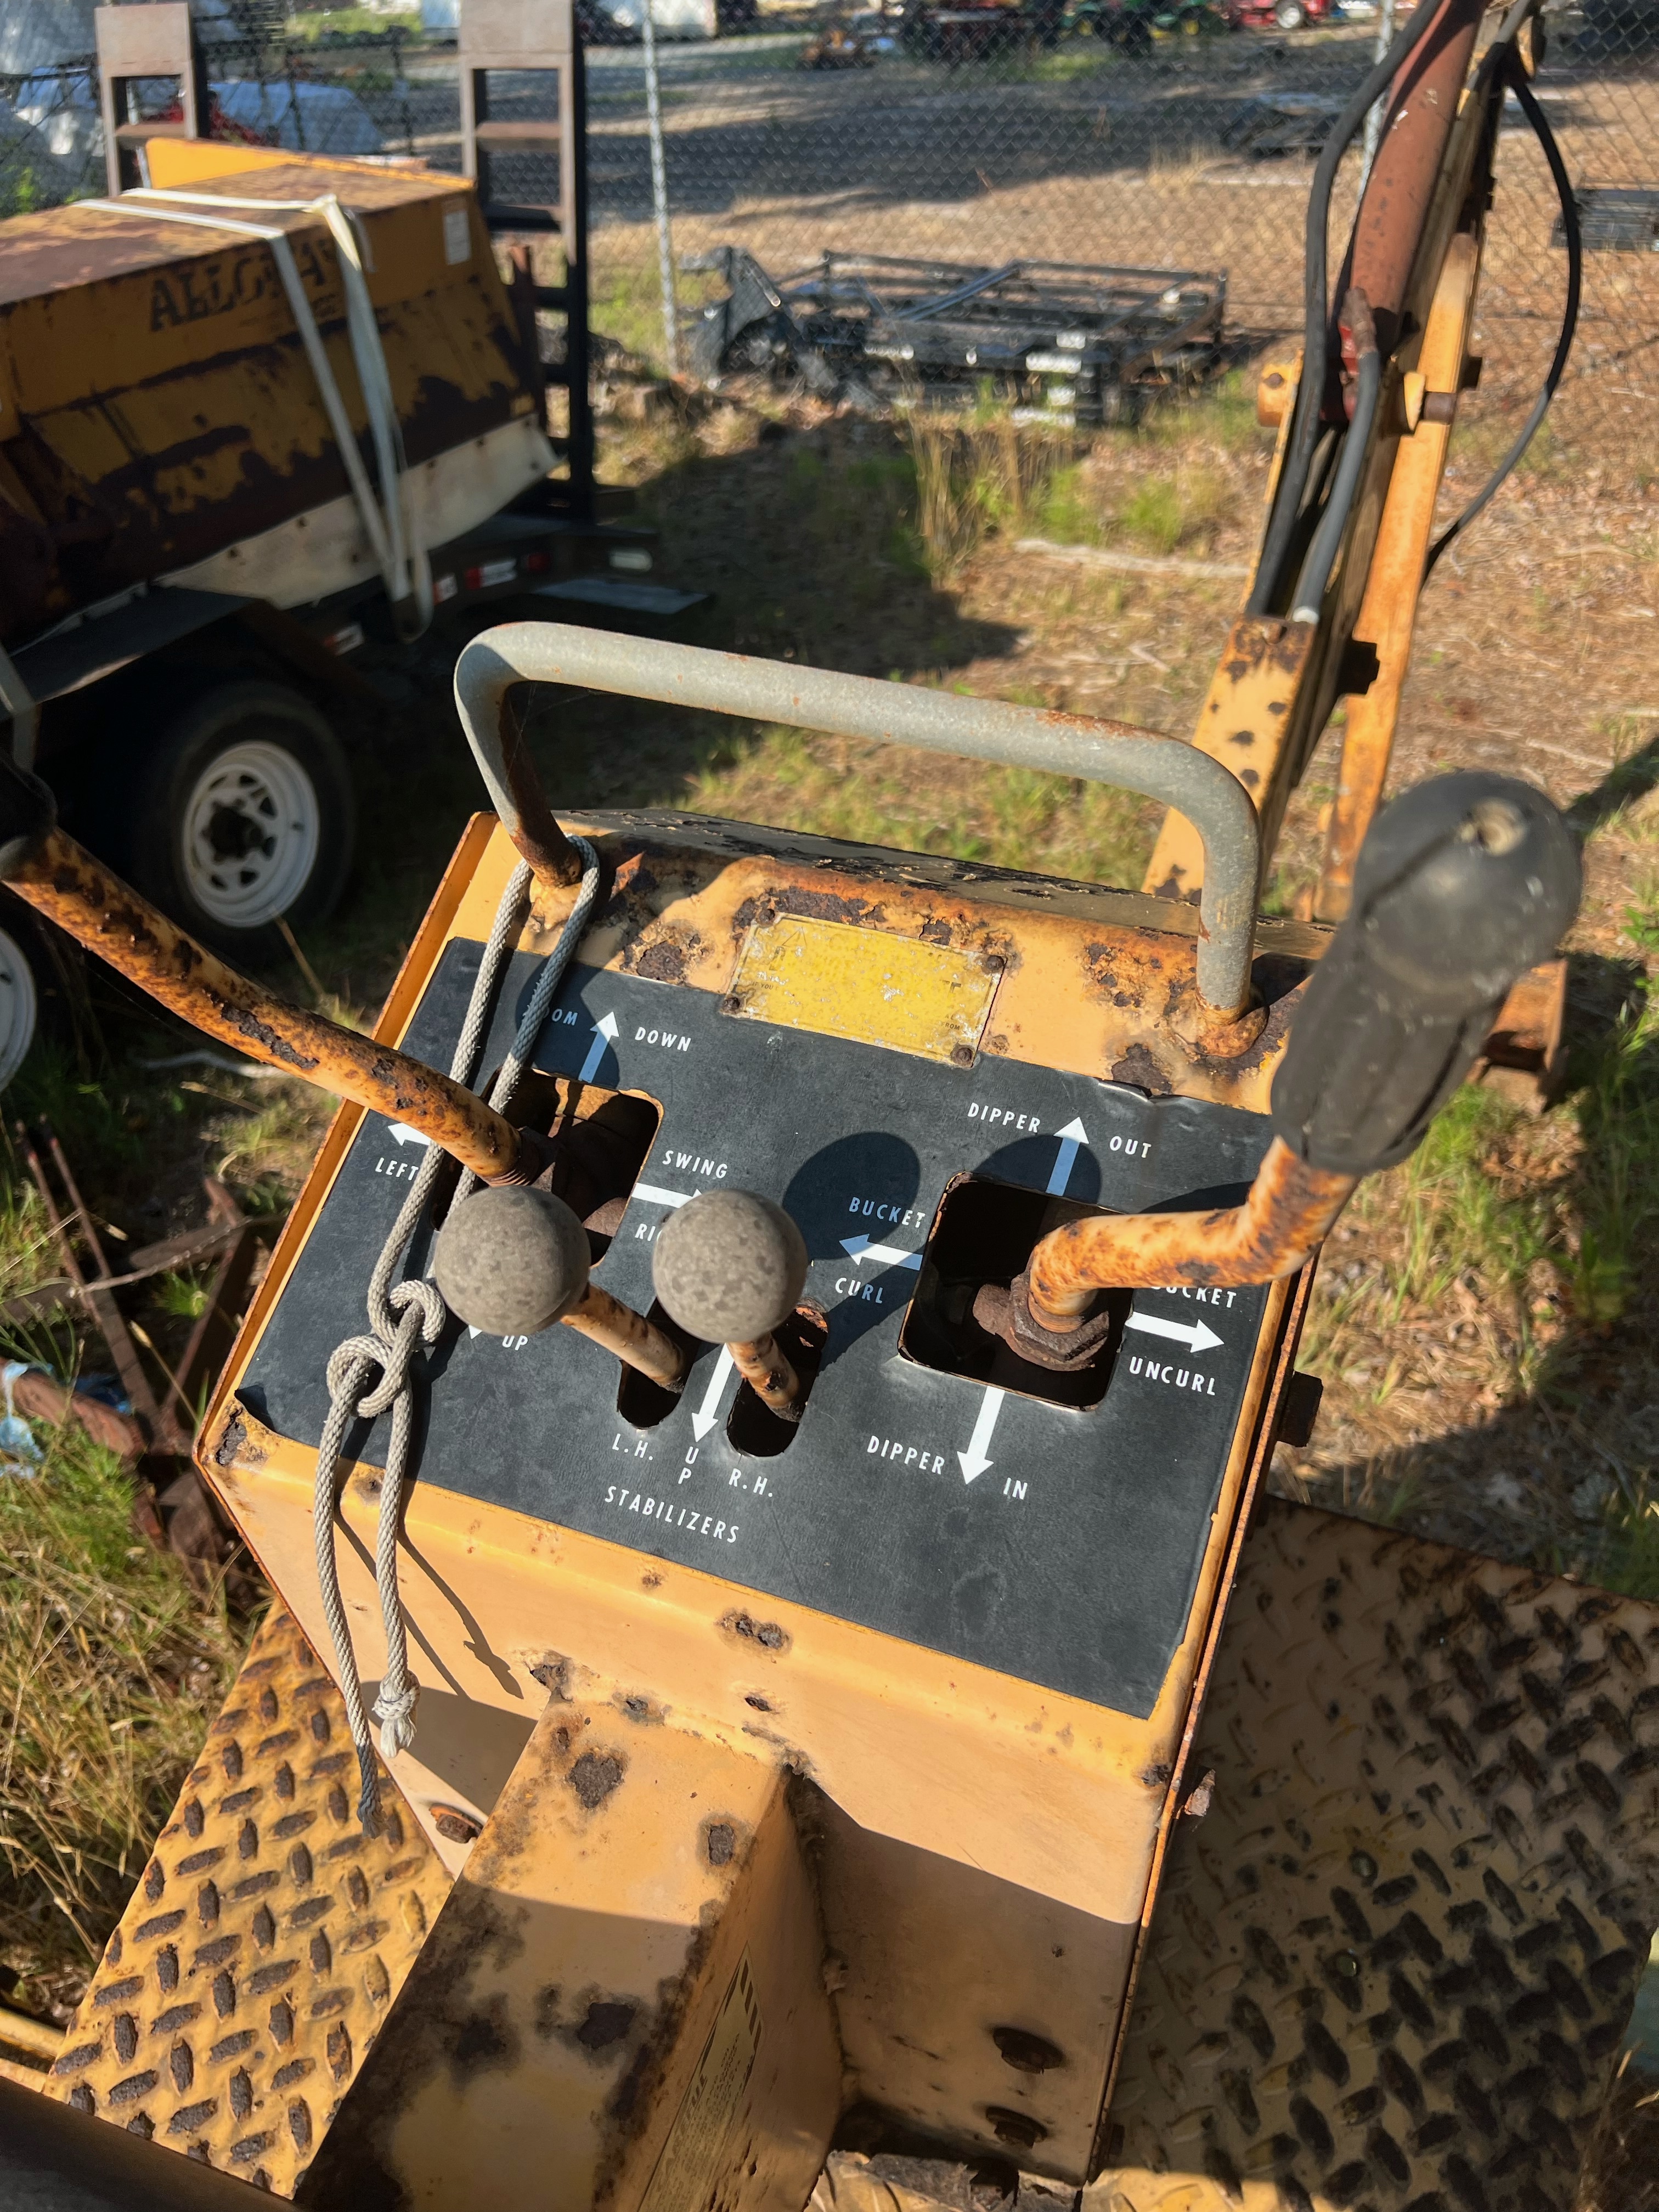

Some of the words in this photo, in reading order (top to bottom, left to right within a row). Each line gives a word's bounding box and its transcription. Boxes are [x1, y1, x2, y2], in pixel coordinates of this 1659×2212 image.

[635, 1026, 691, 1052] DOWN
[967, 1102, 1041, 1133] DIPPER
[1109, 1136, 1152, 1159] OUT
[375, 1157, 419, 1181] LEFT
[662, 1150, 728, 1179] SWING
[849, 1197, 926, 1229] BUCKET
[835, 1277, 884, 1305] CURL
[1150, 1286, 1237, 1308] CKET
[502, 1335, 528, 1351] UP
[1129, 1356, 1216, 1396] UNCURL
[612, 1433, 654, 1461] L.H.
[867, 1435, 945, 1475] DIPPER
[678, 1446, 699, 1485] UP
[729, 1468, 774, 1497] R.H.
[1003, 1477, 1028, 1500] IN
[605, 1485, 740, 1543] STABILIZERS
